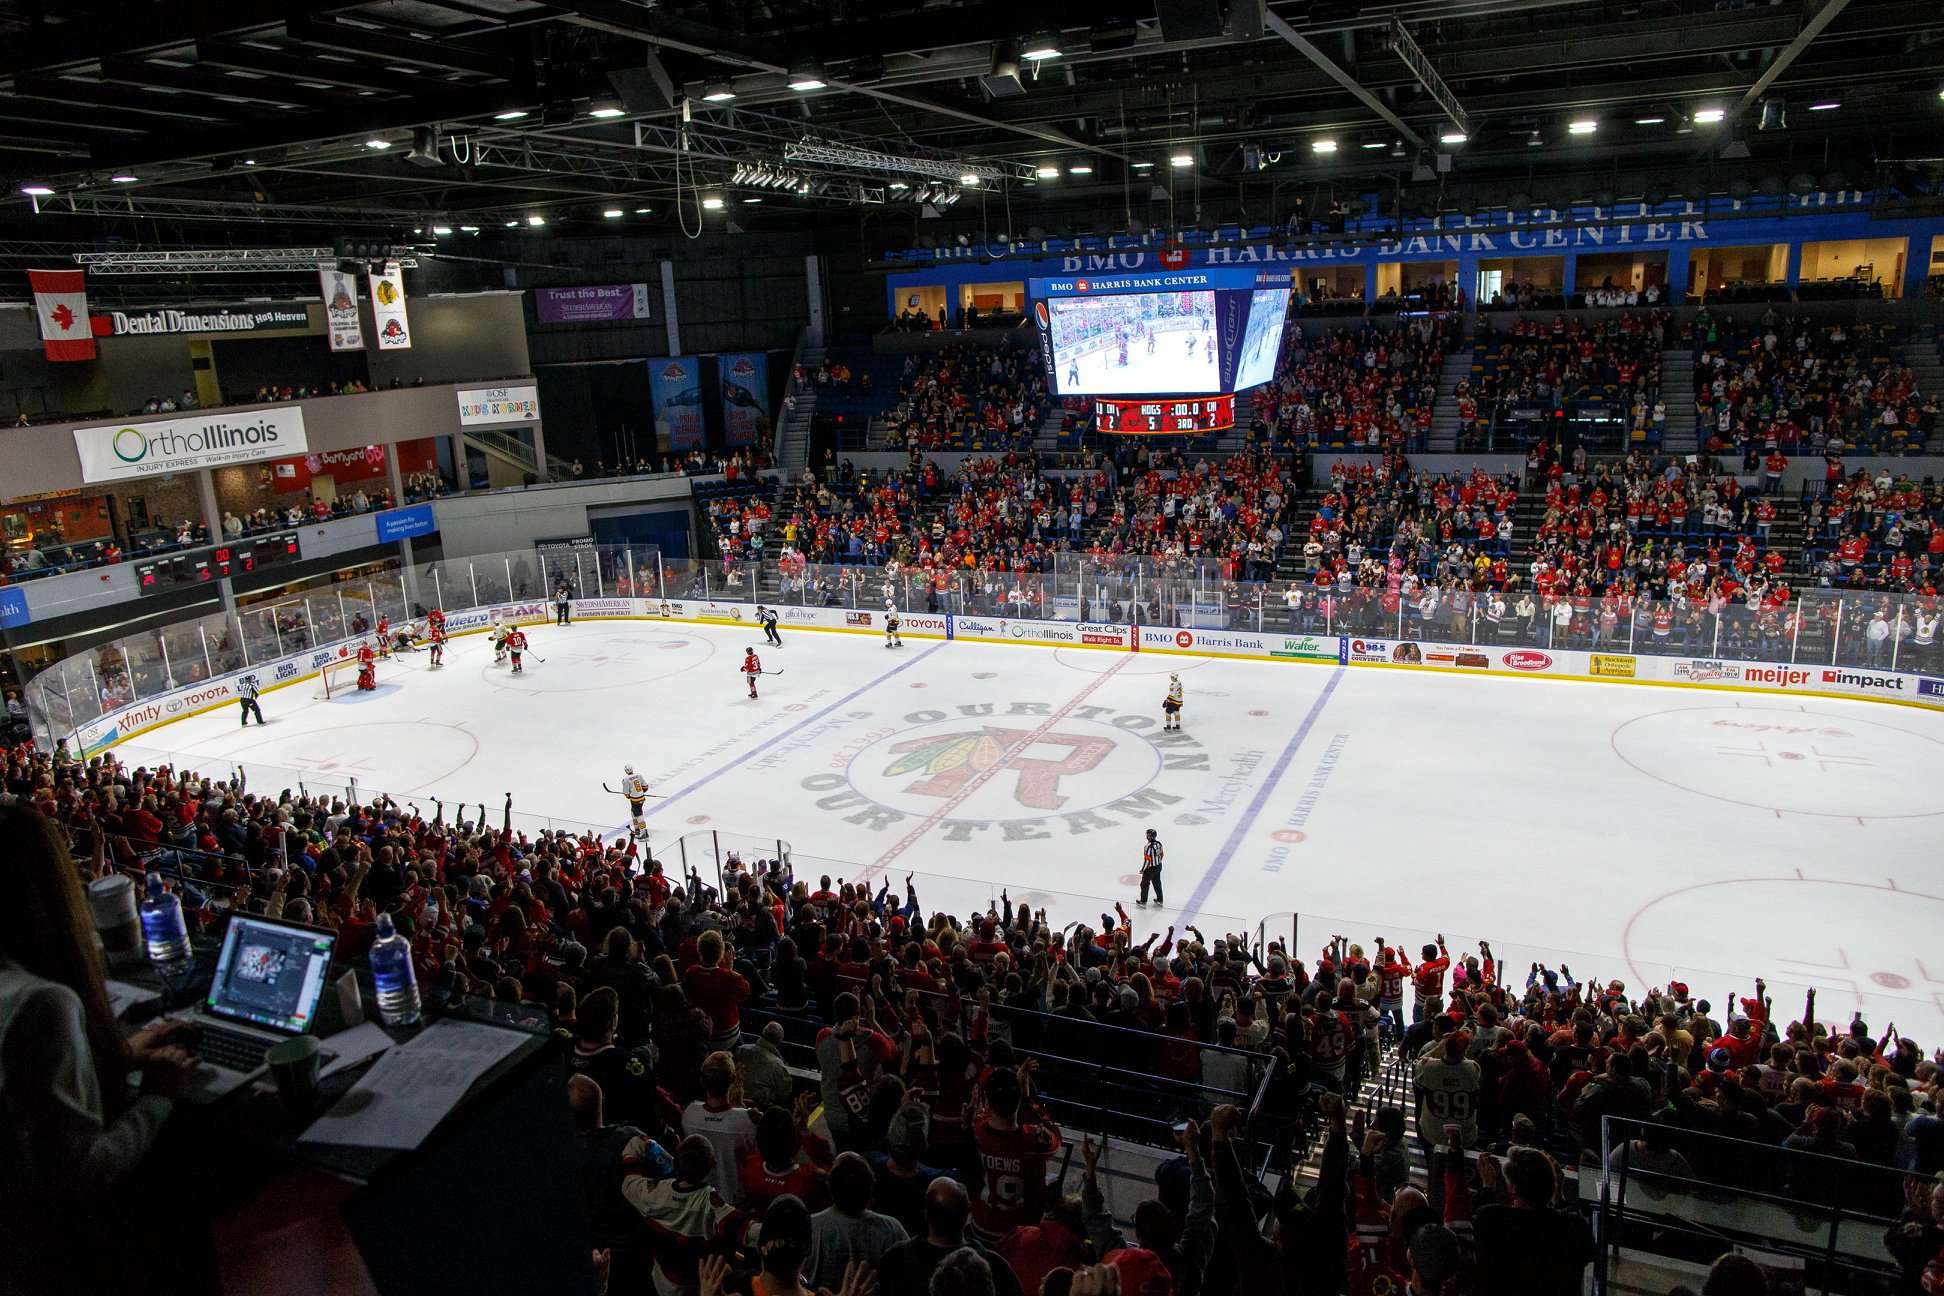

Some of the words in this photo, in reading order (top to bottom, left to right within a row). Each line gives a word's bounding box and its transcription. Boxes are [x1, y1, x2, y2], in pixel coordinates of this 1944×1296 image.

[1205, 239, 1361, 264] HARRIS
[1510, 213, 1709, 249] CENTER
[1051, 282, 1074, 291] BMO
[1092, 279, 1131, 290] HARRIS
[1134, 278, 1162, 287] BANK
[1164, 275, 1208, 286] CENTER
[547, 290, 576, 300] Trust
[578, 289, 594, 298] the
[598, 288, 623, 298] Best.
[112, 310, 167, 335] Dental
[166, 309, 255, 333] Dimensions
[274, 311, 307, 322] Heaven
[1226, 297, 1237, 338] LIGHT
[1040, 333, 1055, 375] pepsi
[1223, 350, 1233, 384] BUD
[1141, 404, 1161, 416] HOGS
[1206, 401, 1218, 412] CHI
[1108, 415, 1114, 429] 2
[1148, 419, 1155, 430] 5
[1209, 413, 1216, 427] 2
[113, 420, 278, 463] OrthoIllinois
[136, 462, 164, 473] INJURY
[165, 458, 199, 469] EXPRESS
[205, 453, 231, 464] Walk-in
[231, 451, 250, 460] Injury
[251, 449, 266, 458] Care
[321, 449, 365, 467] Barnyard
[547, 542, 570, 550] TOYOTA
[489, 604, 545, 618] PEAK
[445, 614, 489, 628] Metro
[905, 618, 945, 629] TOYOTA
[959, 620, 997, 636] Culligan
[1075, 623, 1103, 634] Great
[1104, 624, 1128, 636] Clips
[1011, 625, 1074, 641] OrthoIllinois
[1082, 634, 1097, 643] Walk
[1097, 636, 1112, 645] Right
[1145, 632, 1173, 643] BMO
[1196, 635, 1232, 648] Harris
[1234, 638, 1264, 650] Bank
[314, 652, 330, 662] BUD
[1691, 660, 1722, 670] IRON
[275, 667, 298, 680] LIGHT
[277, 662, 294, 673] BUD
[1745, 665, 1810, 687] meijer
[238, 672, 257, 685] BD
[1836, 669, 1904, 690] impact
[184, 685, 229, 707] TOYOTA
[118, 704, 162, 732] xfinity
[903, 702, 1051, 724] OUR
[1076, 704, 1211, 771] TOWN
[799, 773, 905, 832] OUR
[939, 787, 1185, 842] TEAM
[1316, 1032, 1345, 1058] 49
[1432, 1089, 1471, 1120] 99
[980, 1153, 1021, 1174] TOEWS
